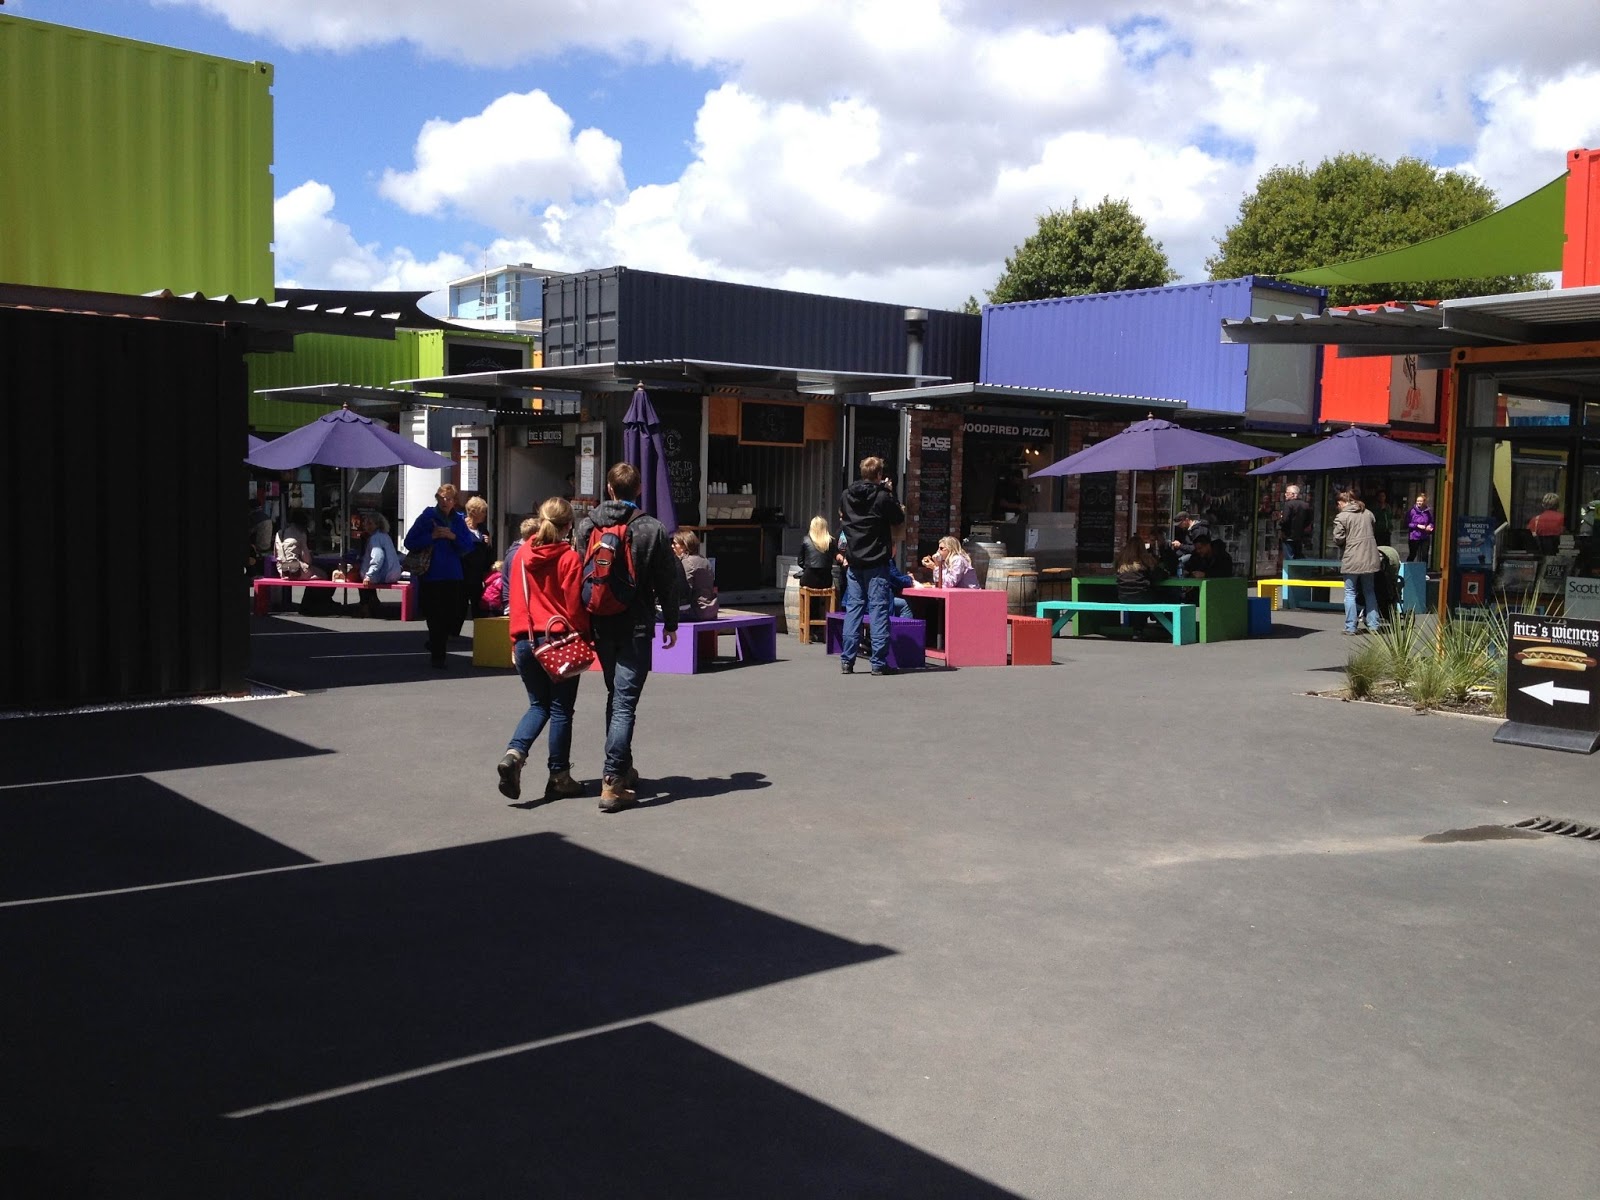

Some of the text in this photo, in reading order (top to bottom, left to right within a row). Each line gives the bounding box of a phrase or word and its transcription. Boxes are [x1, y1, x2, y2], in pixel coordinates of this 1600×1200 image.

[1022, 427, 1050, 437] PIZZA
[921, 436, 951, 449] BASE
[1513, 621, 1600, 642] fritz's wieners
